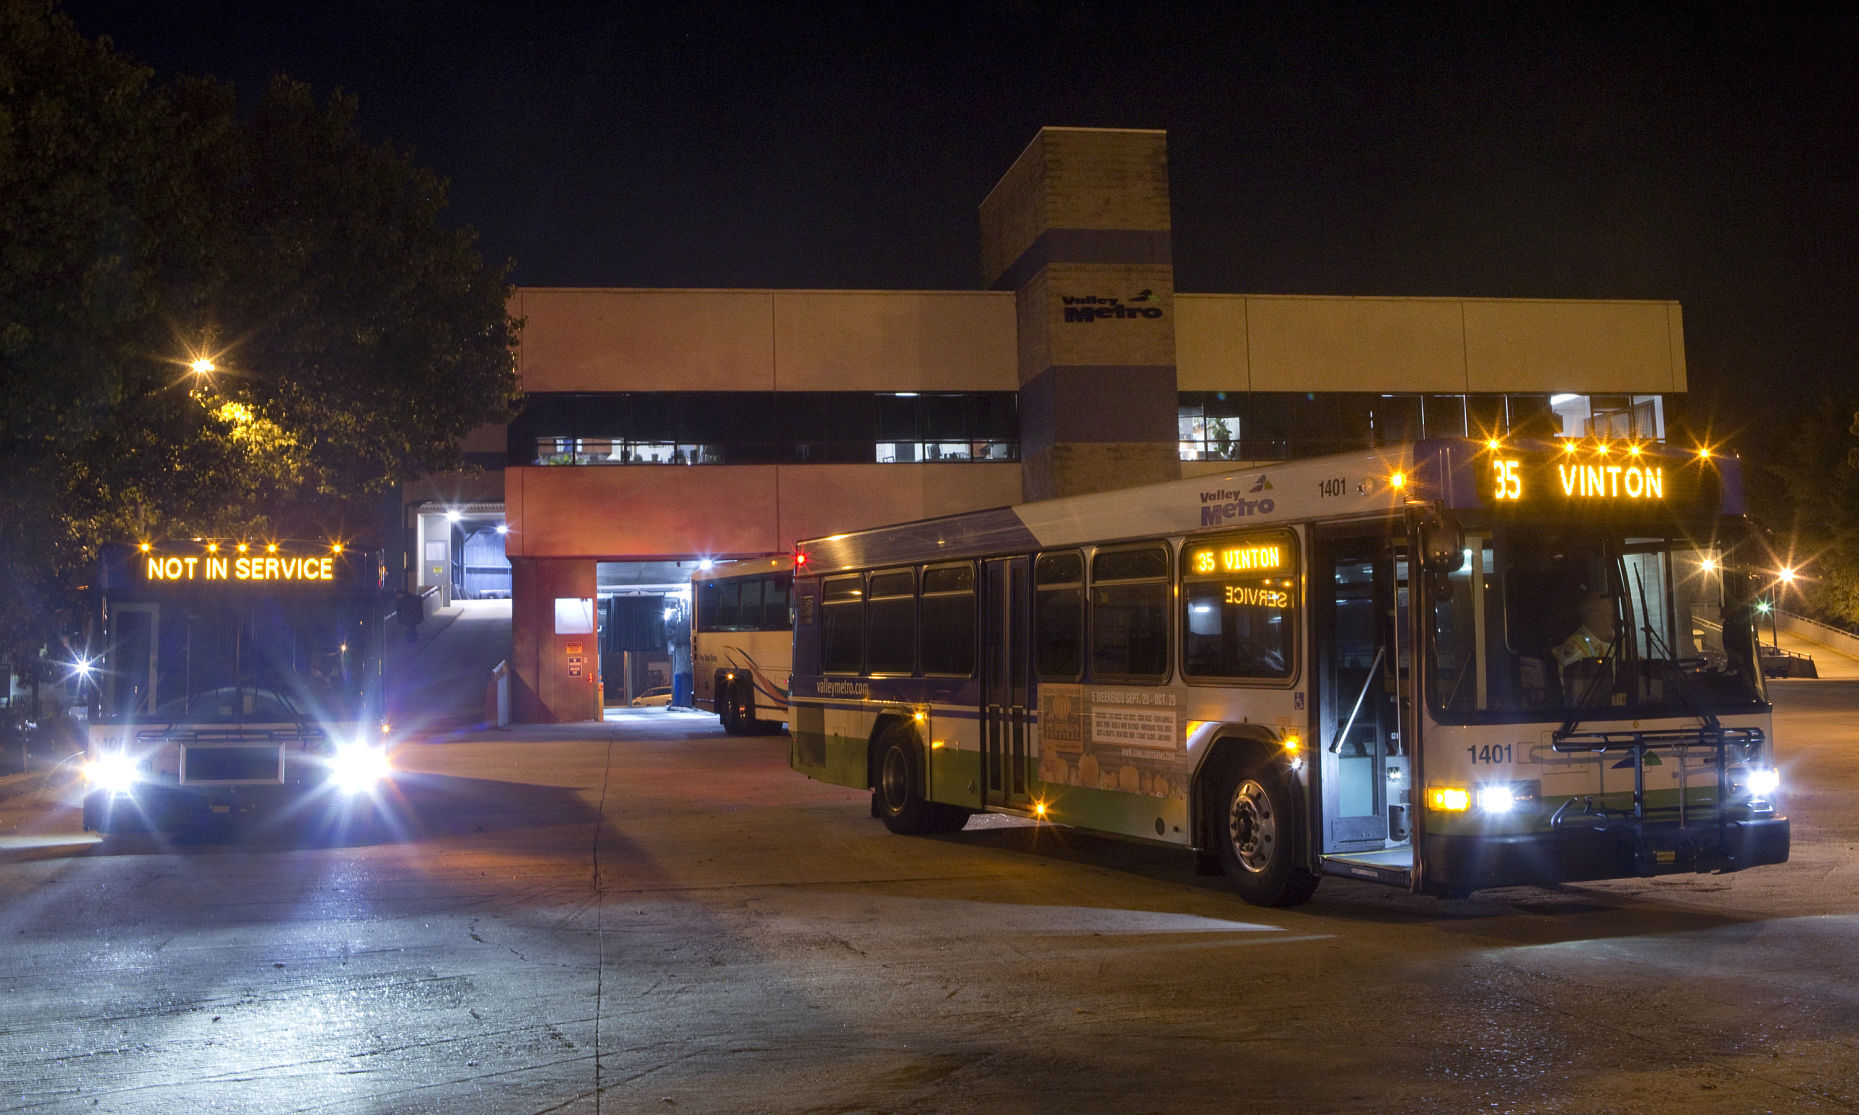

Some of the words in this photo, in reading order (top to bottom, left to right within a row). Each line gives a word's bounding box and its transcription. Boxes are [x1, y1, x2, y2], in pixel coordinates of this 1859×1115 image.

[1062, 295, 1119, 306] Valley
[1064, 304, 1163, 323] Metro
[1319, 478, 1346, 498] 1401
[1493, 459, 1521, 499] 35
[1558, 463, 1663, 498] VINTON
[1200, 489, 1240, 503] Valley
[1200, 498, 1275, 526] Metro
[148, 557, 198, 580] NOT
[206, 557, 227, 580] IN
[236, 557, 333, 580] SERVICE
[1198, 551, 1216, 572] 35
[1224, 546, 1280, 571] VINTON
[816, 676, 869, 697] valleymetro.com
[1467, 743, 1512, 765] 1401
